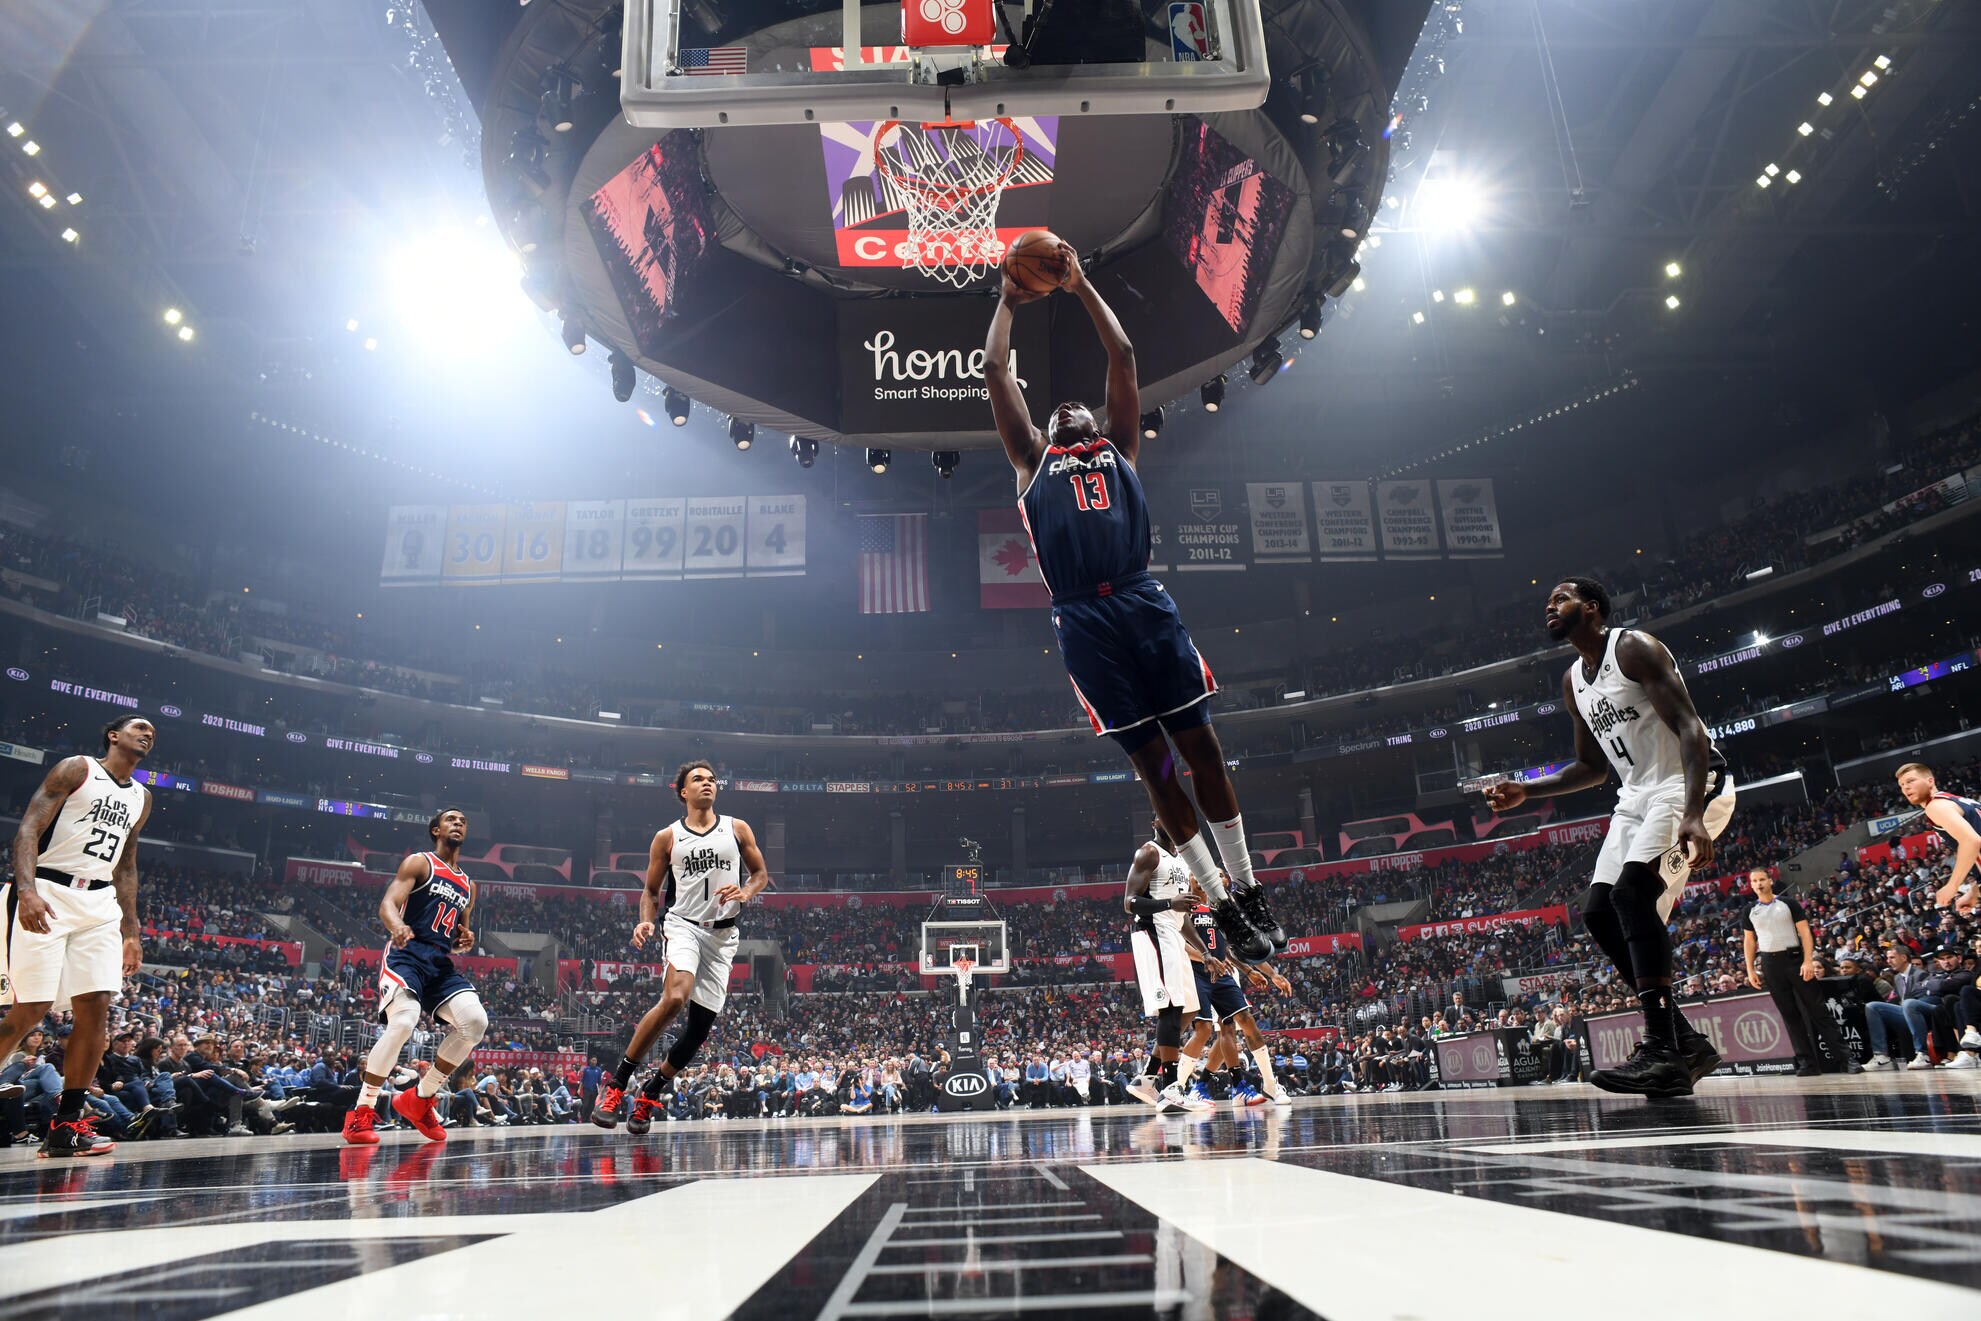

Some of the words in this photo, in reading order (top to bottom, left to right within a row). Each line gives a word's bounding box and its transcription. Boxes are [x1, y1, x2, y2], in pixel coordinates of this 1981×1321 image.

[853, 236, 1007, 261] Cente
[874, 387, 918, 400] Smart
[921, 385, 990, 401] Shopping
[1070, 472, 1111, 511] 13
[575, 510, 615, 520] TAYLOR
[631, 507, 680, 518] GRETZKY
[688, 505, 743, 516] ROBITAILLE
[760, 504, 796, 515] BLAKE
[1259, 511, 1296, 519] WESTERN
[1178, 525, 1217, 534] STANLEY
[1219, 525, 1239, 533] CUP
[1257, 529, 1303, 537] CHAMPIONS
[1323, 527, 1368, 535] CHAMPIONS
[1386, 526, 1432, 534] CHAMPIONS
[1450, 524, 1494, 533] CHAMPIONS
[515, 528, 551, 562] 16
[573, 528, 611, 560] 18
[631, 525, 678, 559] 99
[692, 524, 738, 557] 20
[764, 523, 787, 554] 4
[1178, 534, 1240, 545] CHAMPIONS
[1263, 539, 1298, 549] 2013-14
[1331, 537, 1364, 547] 2011-12
[451, 531, 496, 564] 30
[1189, 548, 1232, 560] 2011-12
[1823, 620, 1842, 636] GIVE
[1842, 617, 1852, 629] IT
[1851, 599, 1902, 626] EVERYTHING
[1698, 660, 1718, 674] 2020
[1718, 647, 1762, 668] TELLURIDE
[1951, 662, 1969, 673] NFL
[1889, 675, 1901, 684] LA
[1891, 681, 1905, 692] ARI
[51, 679, 73, 694] GIVE
[73, 685, 83, 697] IT
[84, 687, 139, 708] EVERYTHING
[1589, 697, 1611, 718] Los
[202, 713, 223, 728] 2020
[225, 718, 266, 737] TELLURIDE
[1464, 720, 1482, 733] 2020
[1483, 712, 1520, 729] TELLURIDE
[1591, 704, 1641, 739] Angeles
[326, 738, 343, 750] GIVE
[345, 741, 353, 751] IT
[354, 742, 399, 759] EVERYTHING
[1339, 739, 1380, 755] Spectrum
[1609, 735, 1635, 766] 4
[451, 758, 471, 769] 2020
[472, 759, 510, 773] TELLURIDE
[1226, 759, 1240, 767] WAS
[524, 766, 545, 775] WELLS
[546, 768, 566, 777] FARGO
[1096, 774, 1108, 782] BUD
[1108, 773, 1126, 781] LIGHT
[176, 781, 191, 792] NFL
[202, 782, 254, 800] TOSHIBA
[792, 783, 824, 791] DELTA
[827, 783, 869, 792] STAPLES
[905, 783, 916, 792] 52
[1000, 780, 1011, 790] 37
[104, 794, 128, 815] Los
[265, 795, 281, 803] BUD
[282, 797, 303, 807] LIGHT
[373, 811, 388, 820] NFL
[407, 813, 432, 823] DELT
[1879, 820, 1897, 830] UCLA
[1559, 823, 1601, 844] CLIPPERS
[83, 827, 120, 863] 23
[690, 846, 716, 861] Los
[680, 853, 732, 881] Angeles
[956, 868, 978, 879] 8:45
[308, 867, 353, 886] CLIPPERS
[704, 877, 709, 901] 1
[966, 879, 976, 896] 7
[431, 902, 458, 938] 14
[1207, 928, 1216, 949] 3
[1095, 955, 1115, 963] CLIPPERS
[1740, 1021, 1774, 1045] KIA
[1599, 1026, 1634, 1064] 2020
[1513, 1056, 1541, 1067] AGUA
[951, 1077, 981, 1093] KIA
